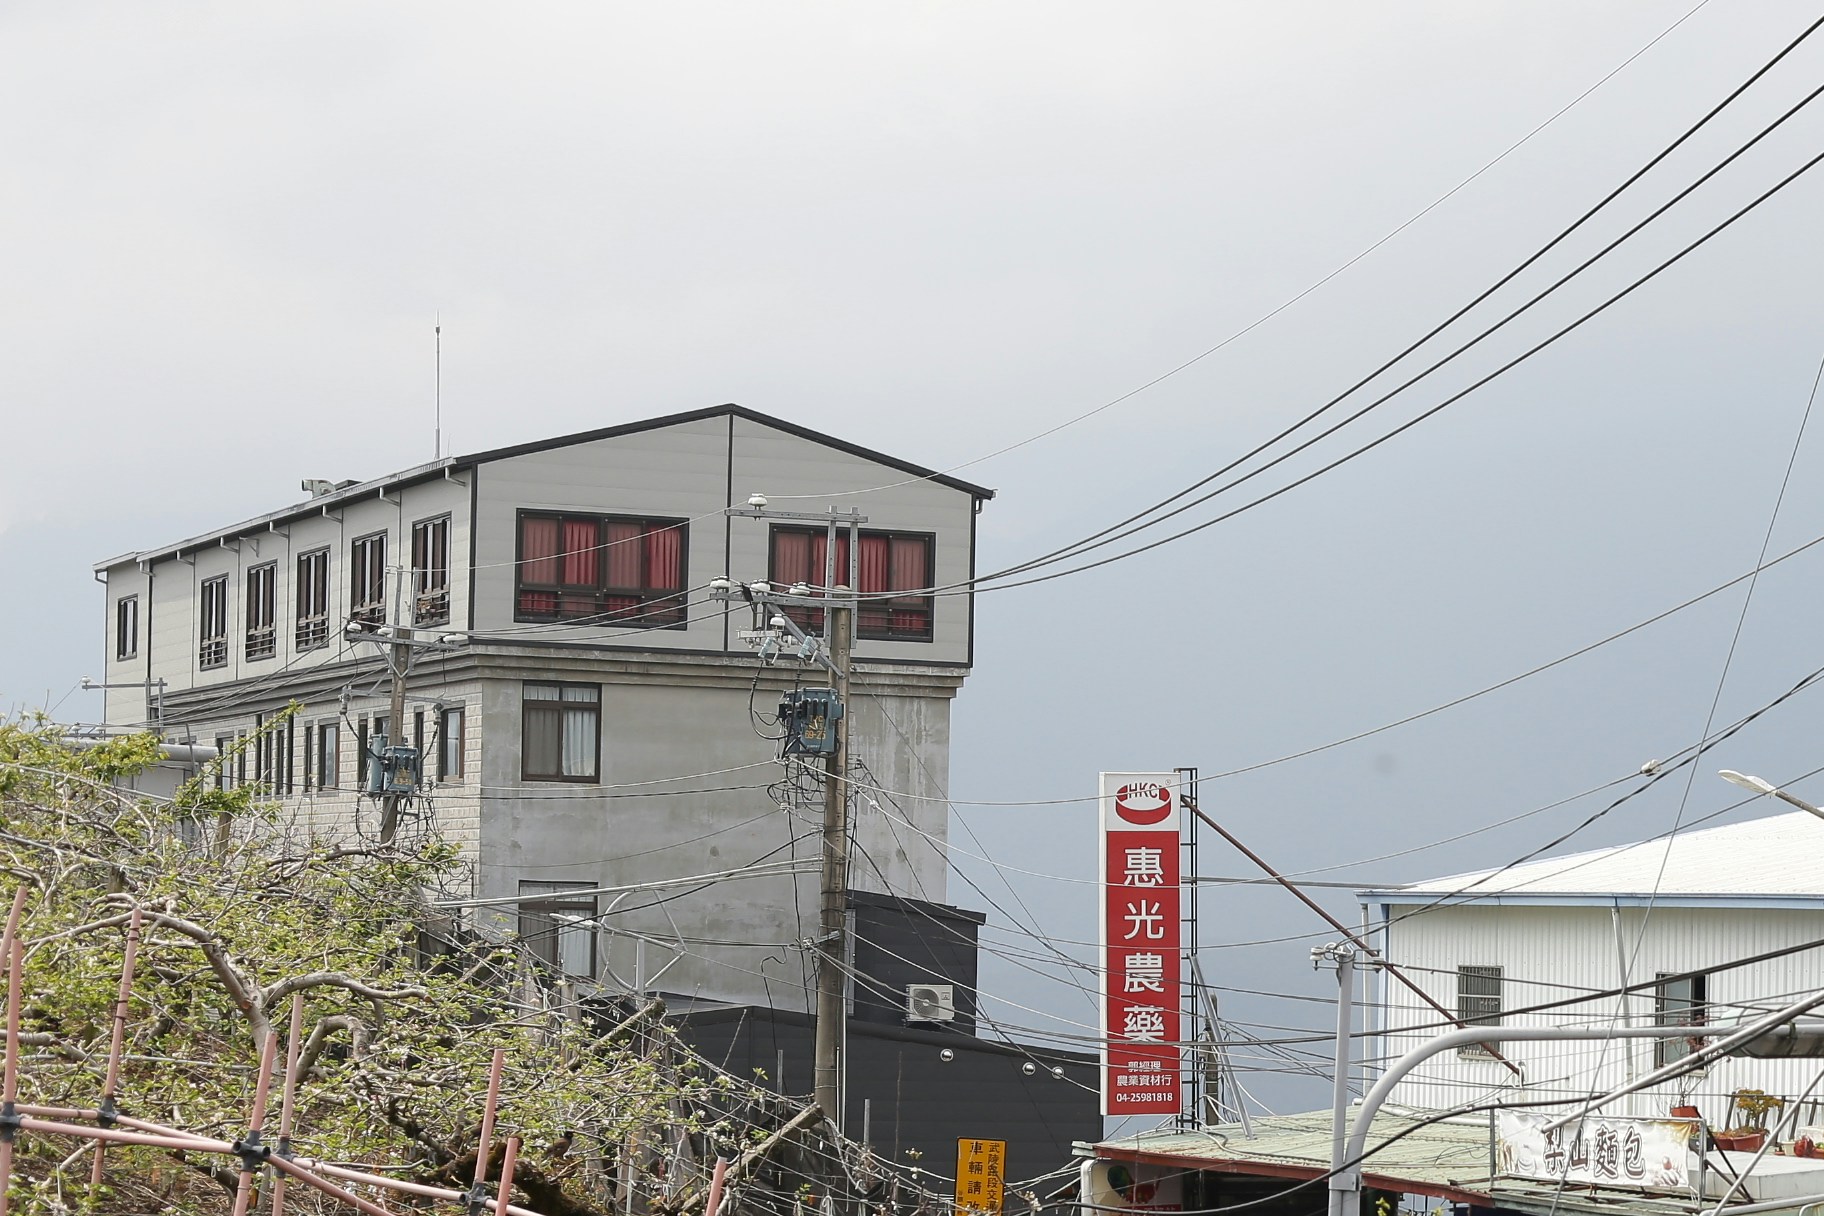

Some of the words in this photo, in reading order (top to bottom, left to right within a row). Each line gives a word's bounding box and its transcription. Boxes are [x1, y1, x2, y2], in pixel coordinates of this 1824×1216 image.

[1123, 846, 1165, 1043] 惠光農藥
[1116, 1074, 1173, 1087] 農業資材行
[1116, 1092, 1173, 1103] 04-25981818
[1543, 1125, 1647, 1180] 梨山麵包
